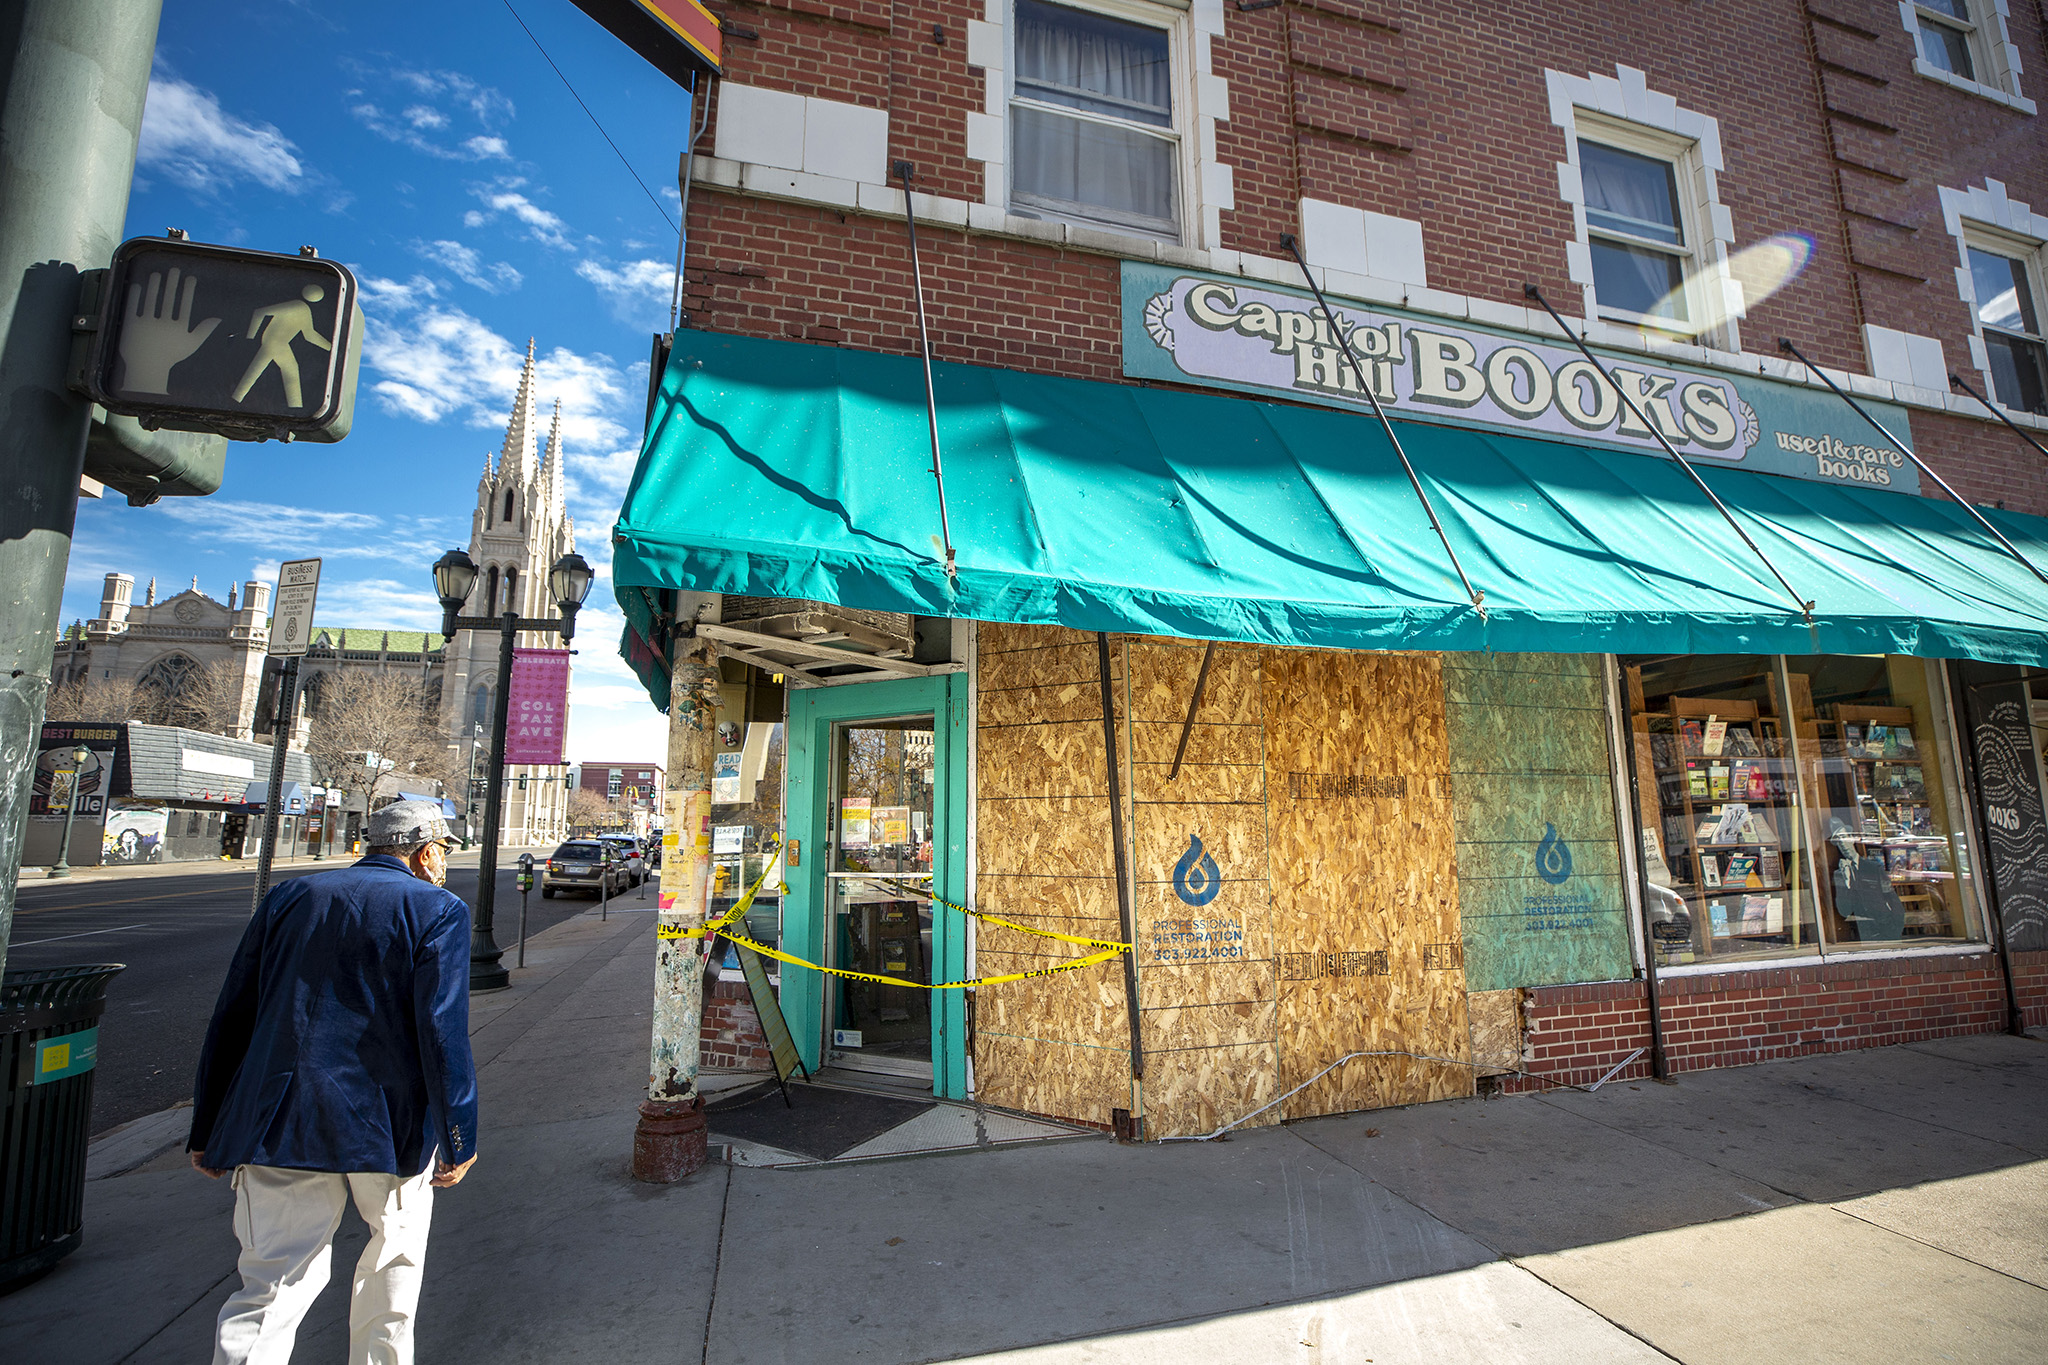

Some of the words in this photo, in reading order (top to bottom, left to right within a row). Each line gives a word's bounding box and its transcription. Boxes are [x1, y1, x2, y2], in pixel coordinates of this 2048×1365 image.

[1187, 283, 1405, 363] Capitol
[1294, 341, 1397, 402] Hill
[1409, 327, 1739, 445] BOOKS
[1816, 454, 1891, 485] books
[287, 565, 313, 575] BUSINESS
[289, 575, 307, 583] WATCH
[516, 657, 566, 665] CELEBRATE
[521, 701, 554, 711] COL
[520, 713, 553, 724] FAX
[42, 728, 72, 739] BEST
[73, 728, 118, 740] BURGER
[519, 727, 552, 737] AVE
[718, 754, 741, 765] READ
[1987, 804, 2020, 830] OOKS
[1523, 894, 1591, 905] PROFESSIONAL
[1525, 905, 1593, 916] RESTORATION
[1153, 919, 1242, 931] PROFESSIONAL
[1154, 931, 1242, 944] RESTORATION
[1154, 946, 1243, 960] 303.922.4001
